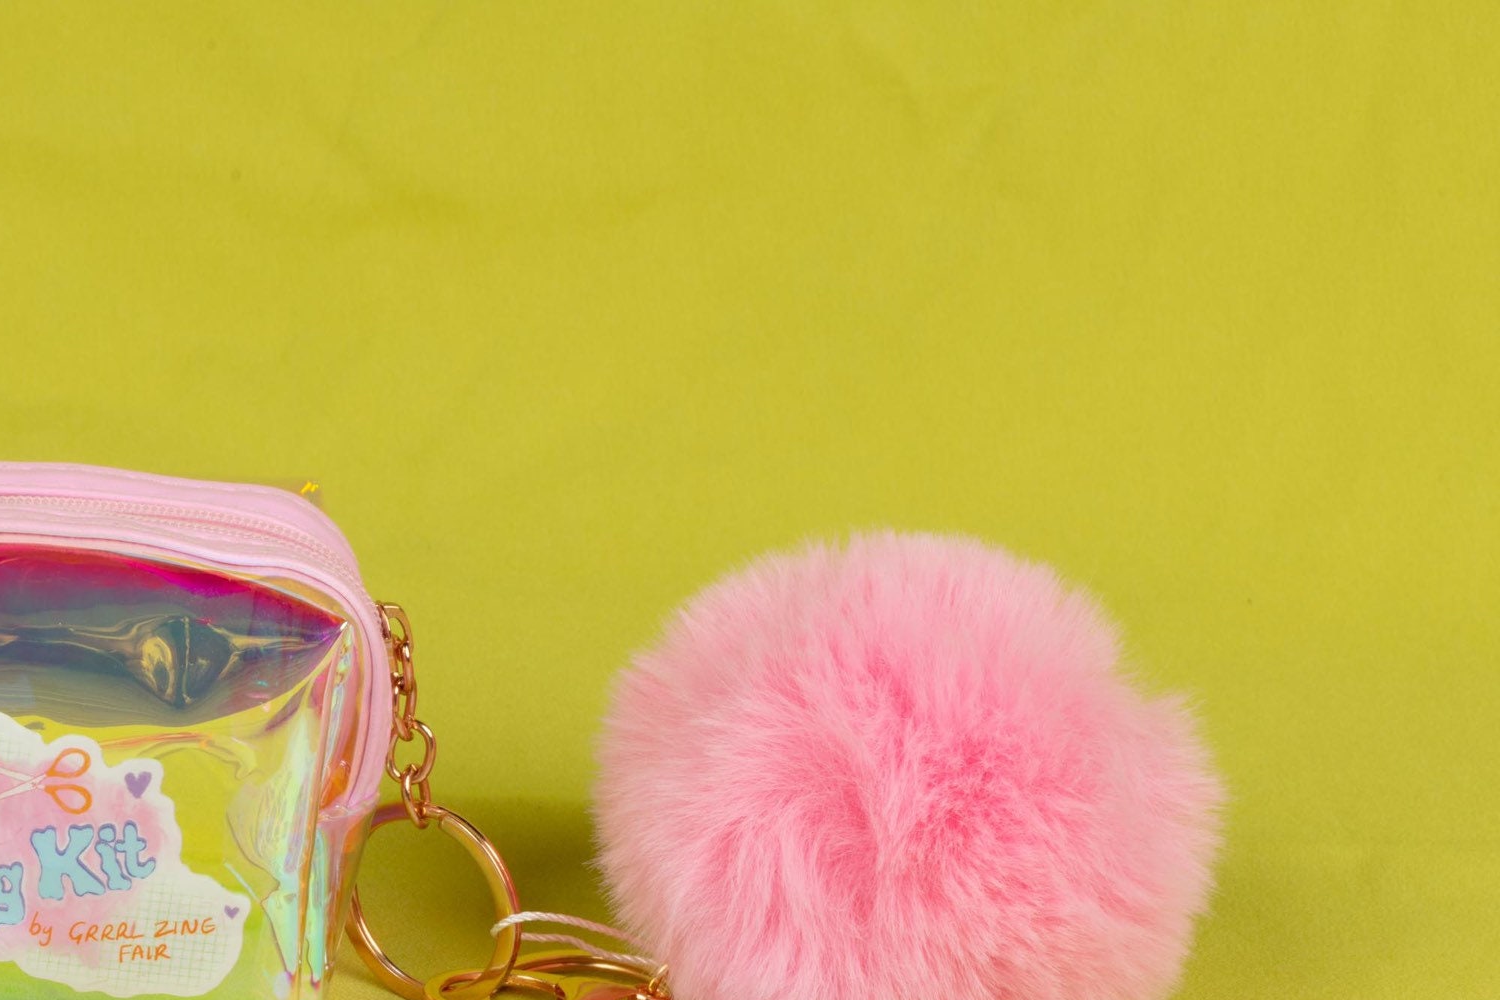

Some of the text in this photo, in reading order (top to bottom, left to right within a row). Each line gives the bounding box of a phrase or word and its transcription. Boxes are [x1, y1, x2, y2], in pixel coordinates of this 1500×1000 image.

[31, 820, 157, 901] Kit
[29, 911, 217, 947] by GRRRL ZINE
[119, 944, 171, 963] FAIR
